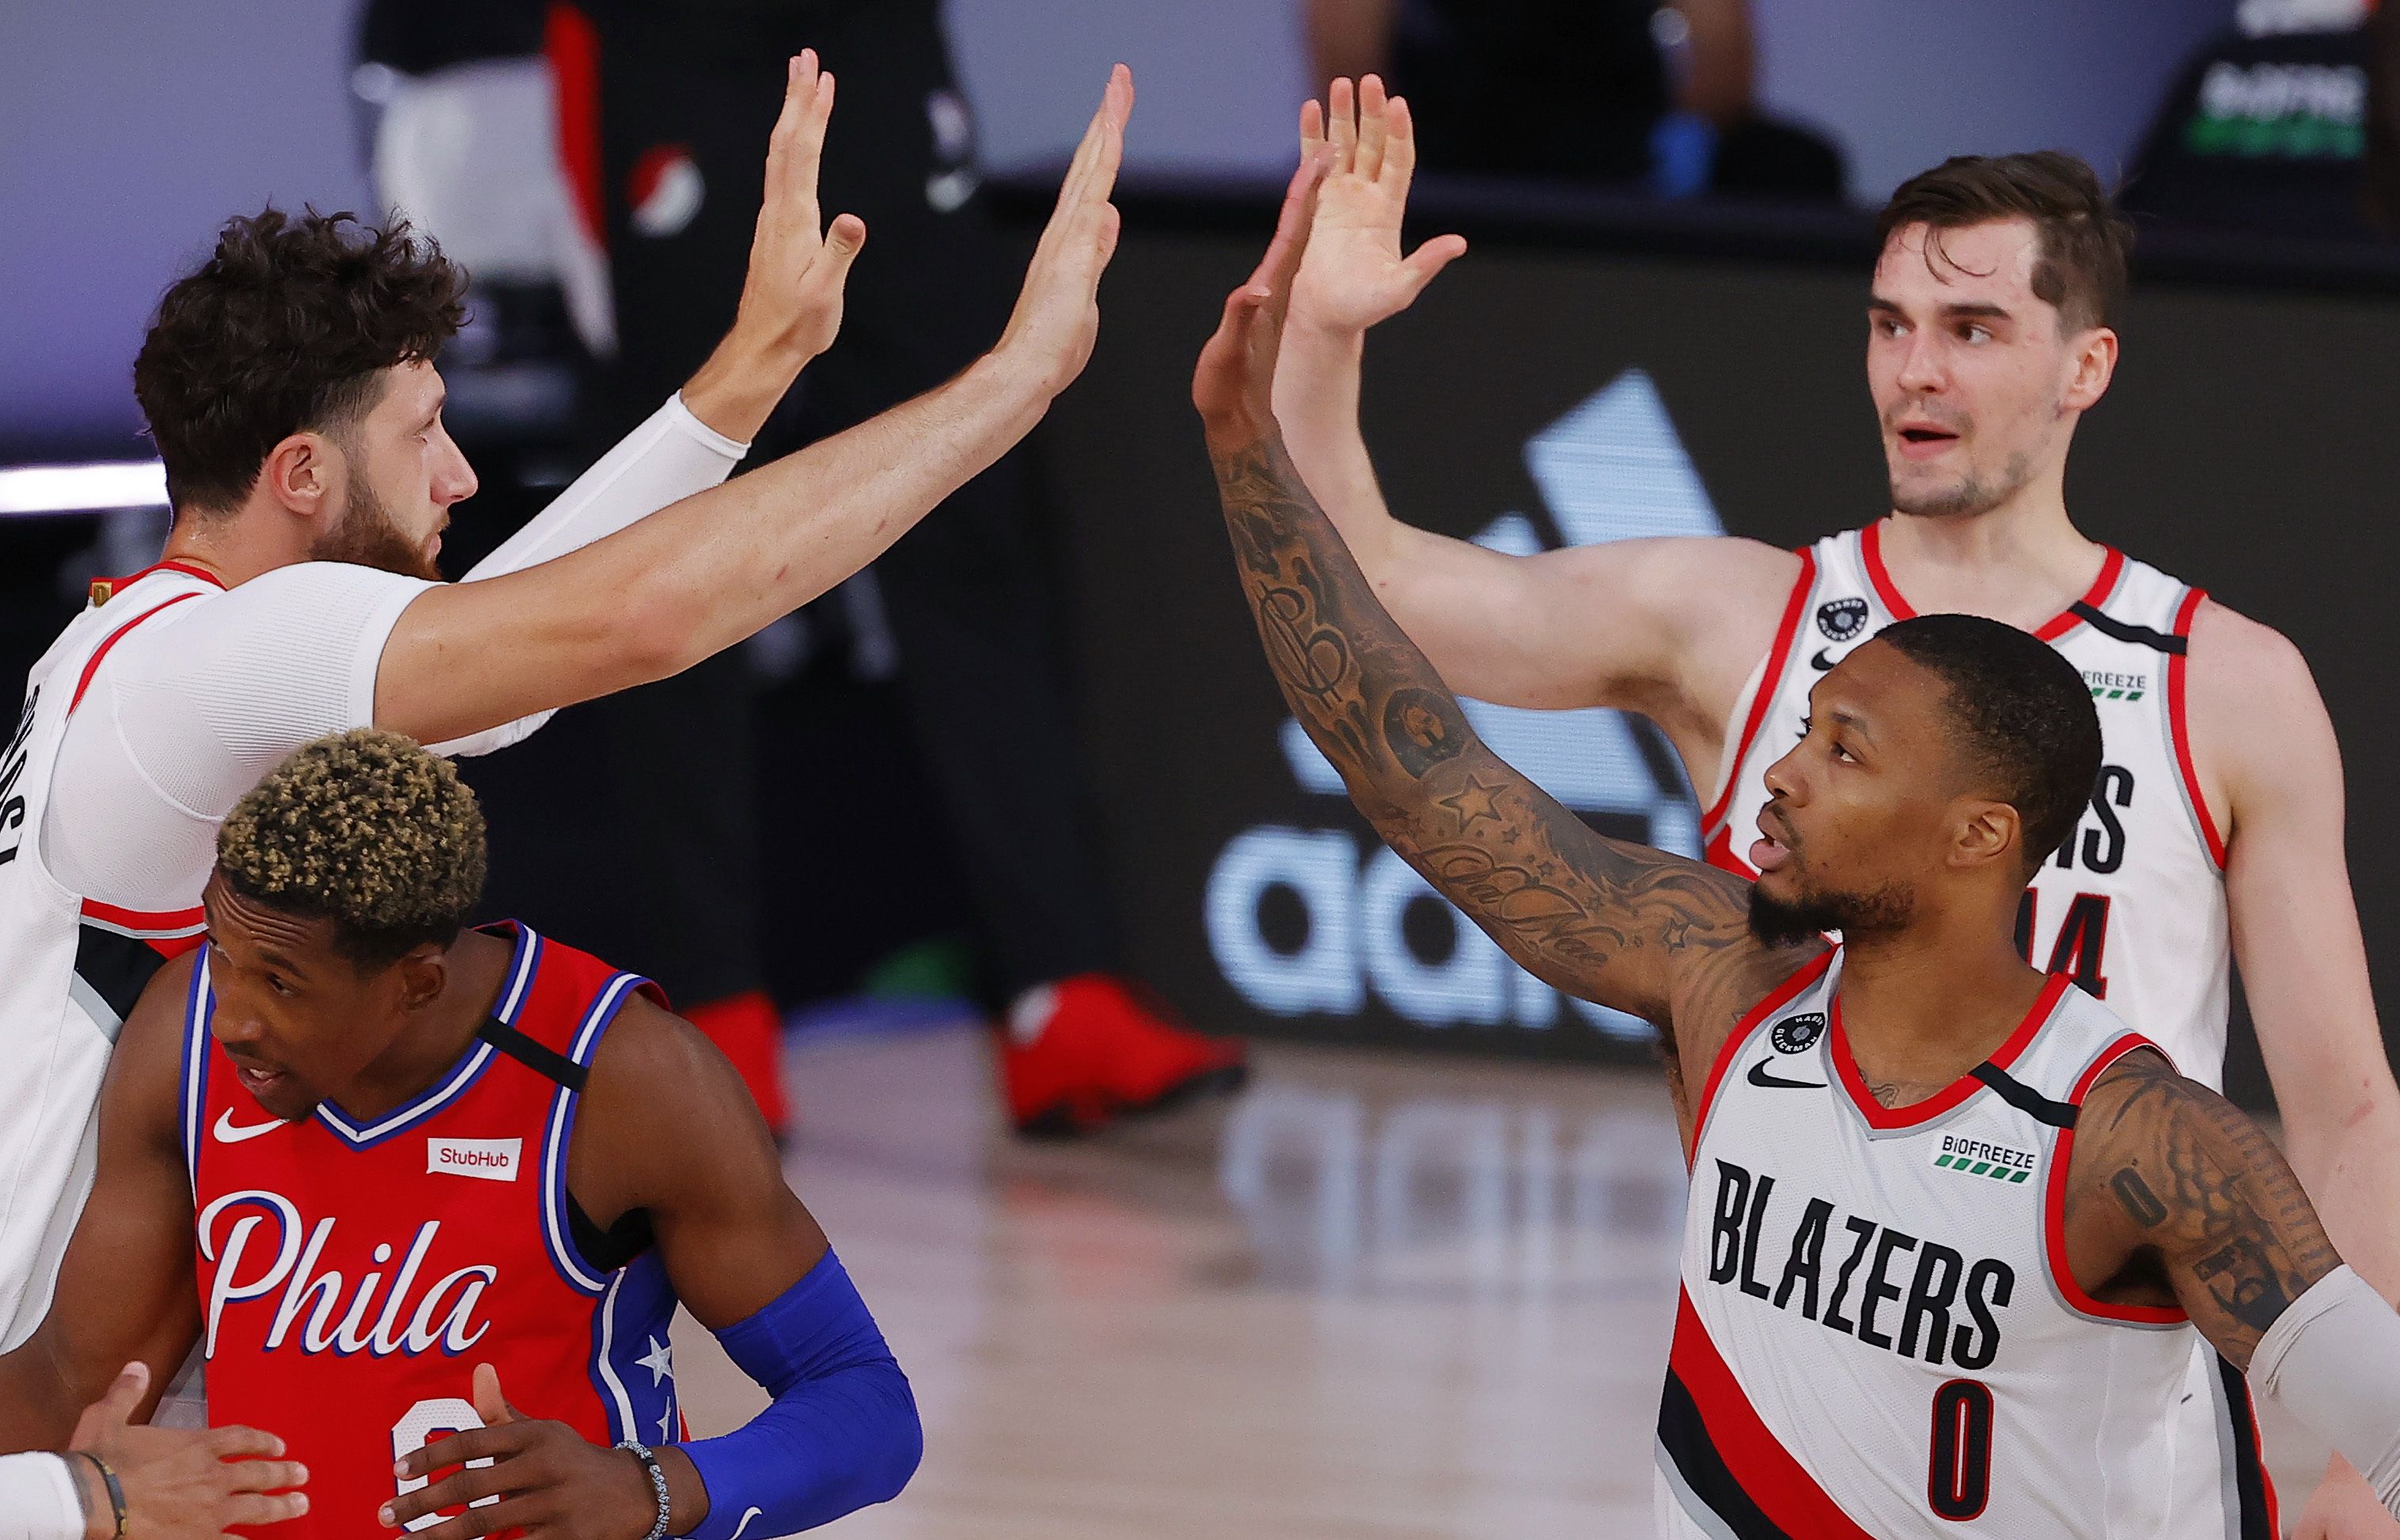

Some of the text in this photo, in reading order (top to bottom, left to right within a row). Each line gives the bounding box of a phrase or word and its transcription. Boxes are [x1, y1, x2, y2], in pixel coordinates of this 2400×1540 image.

[439, 1147, 509, 1167] StubHub
[196, 1189, 497, 1360] Phila
[1708, 1158, 2015, 1371] BLAZERS
[1928, 1379, 1994, 1522] 0
